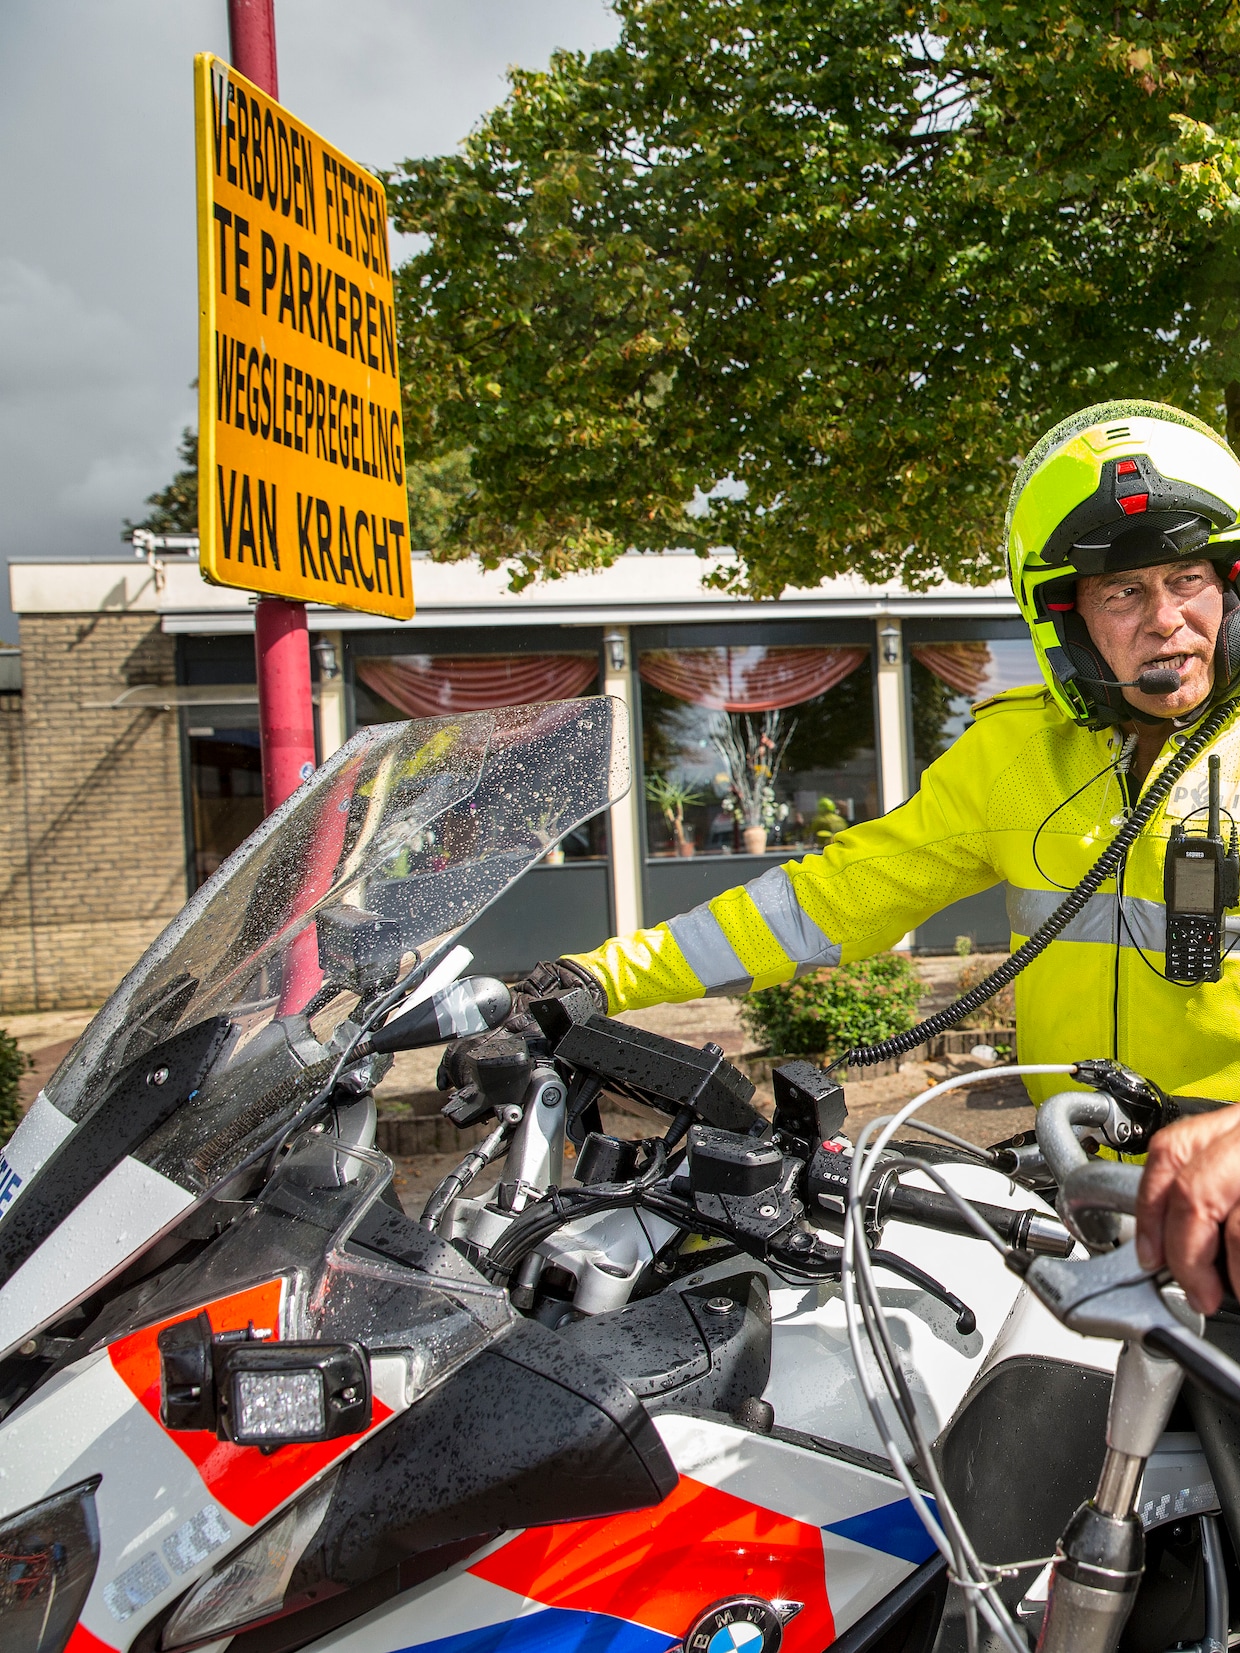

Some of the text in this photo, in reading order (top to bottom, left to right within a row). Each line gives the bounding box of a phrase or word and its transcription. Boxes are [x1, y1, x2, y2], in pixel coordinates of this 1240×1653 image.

[210, 66, 390, 282] VERBODEN FIETSEN
[213, 202, 397, 379] TE PARKEREN
[215, 330, 403, 486] WEGSLEEPREGELING
[217, 464, 405, 598] VAN KRACHT
[692, 1606, 767, 1649] BMW
